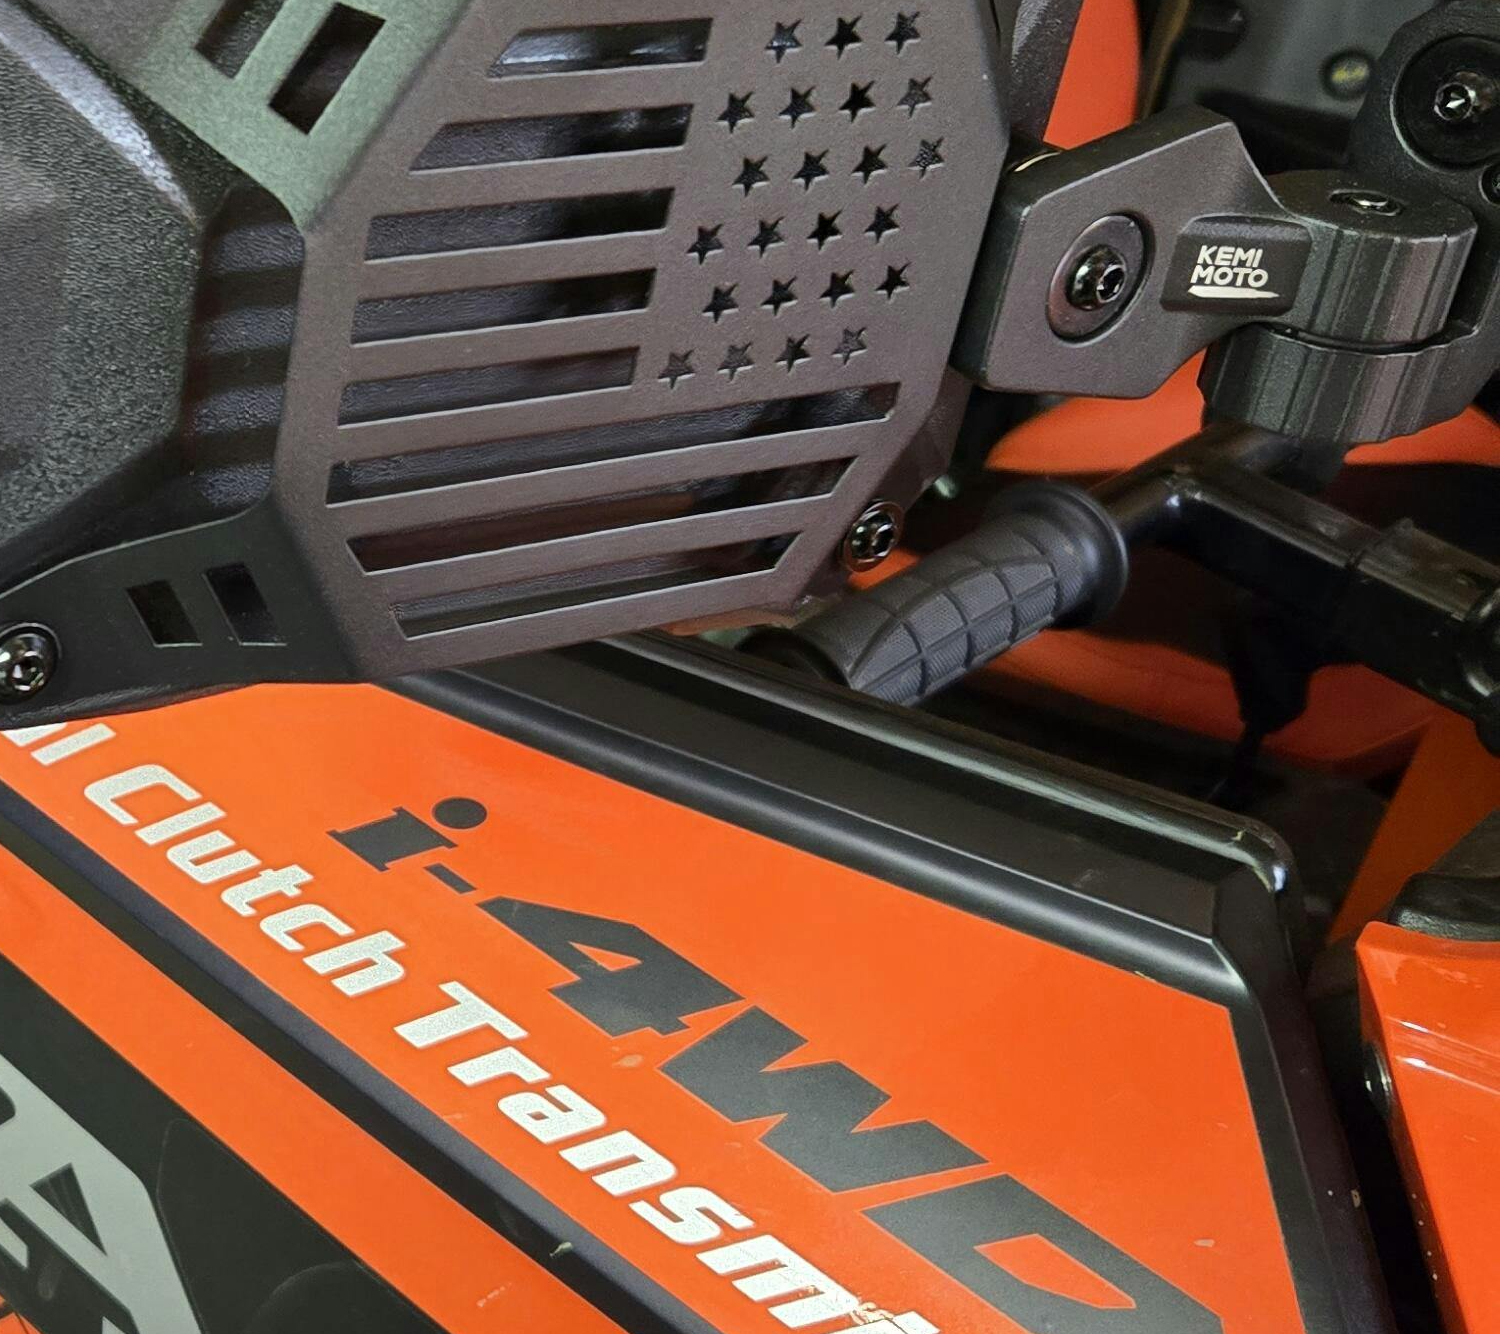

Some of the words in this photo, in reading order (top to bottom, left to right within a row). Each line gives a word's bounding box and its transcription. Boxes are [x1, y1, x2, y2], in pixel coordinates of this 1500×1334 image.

[1196, 244, 1263, 267] KEMI
[1189, 264, 1269, 288] MOTO
[83, 763, 406, 998] Clutch
